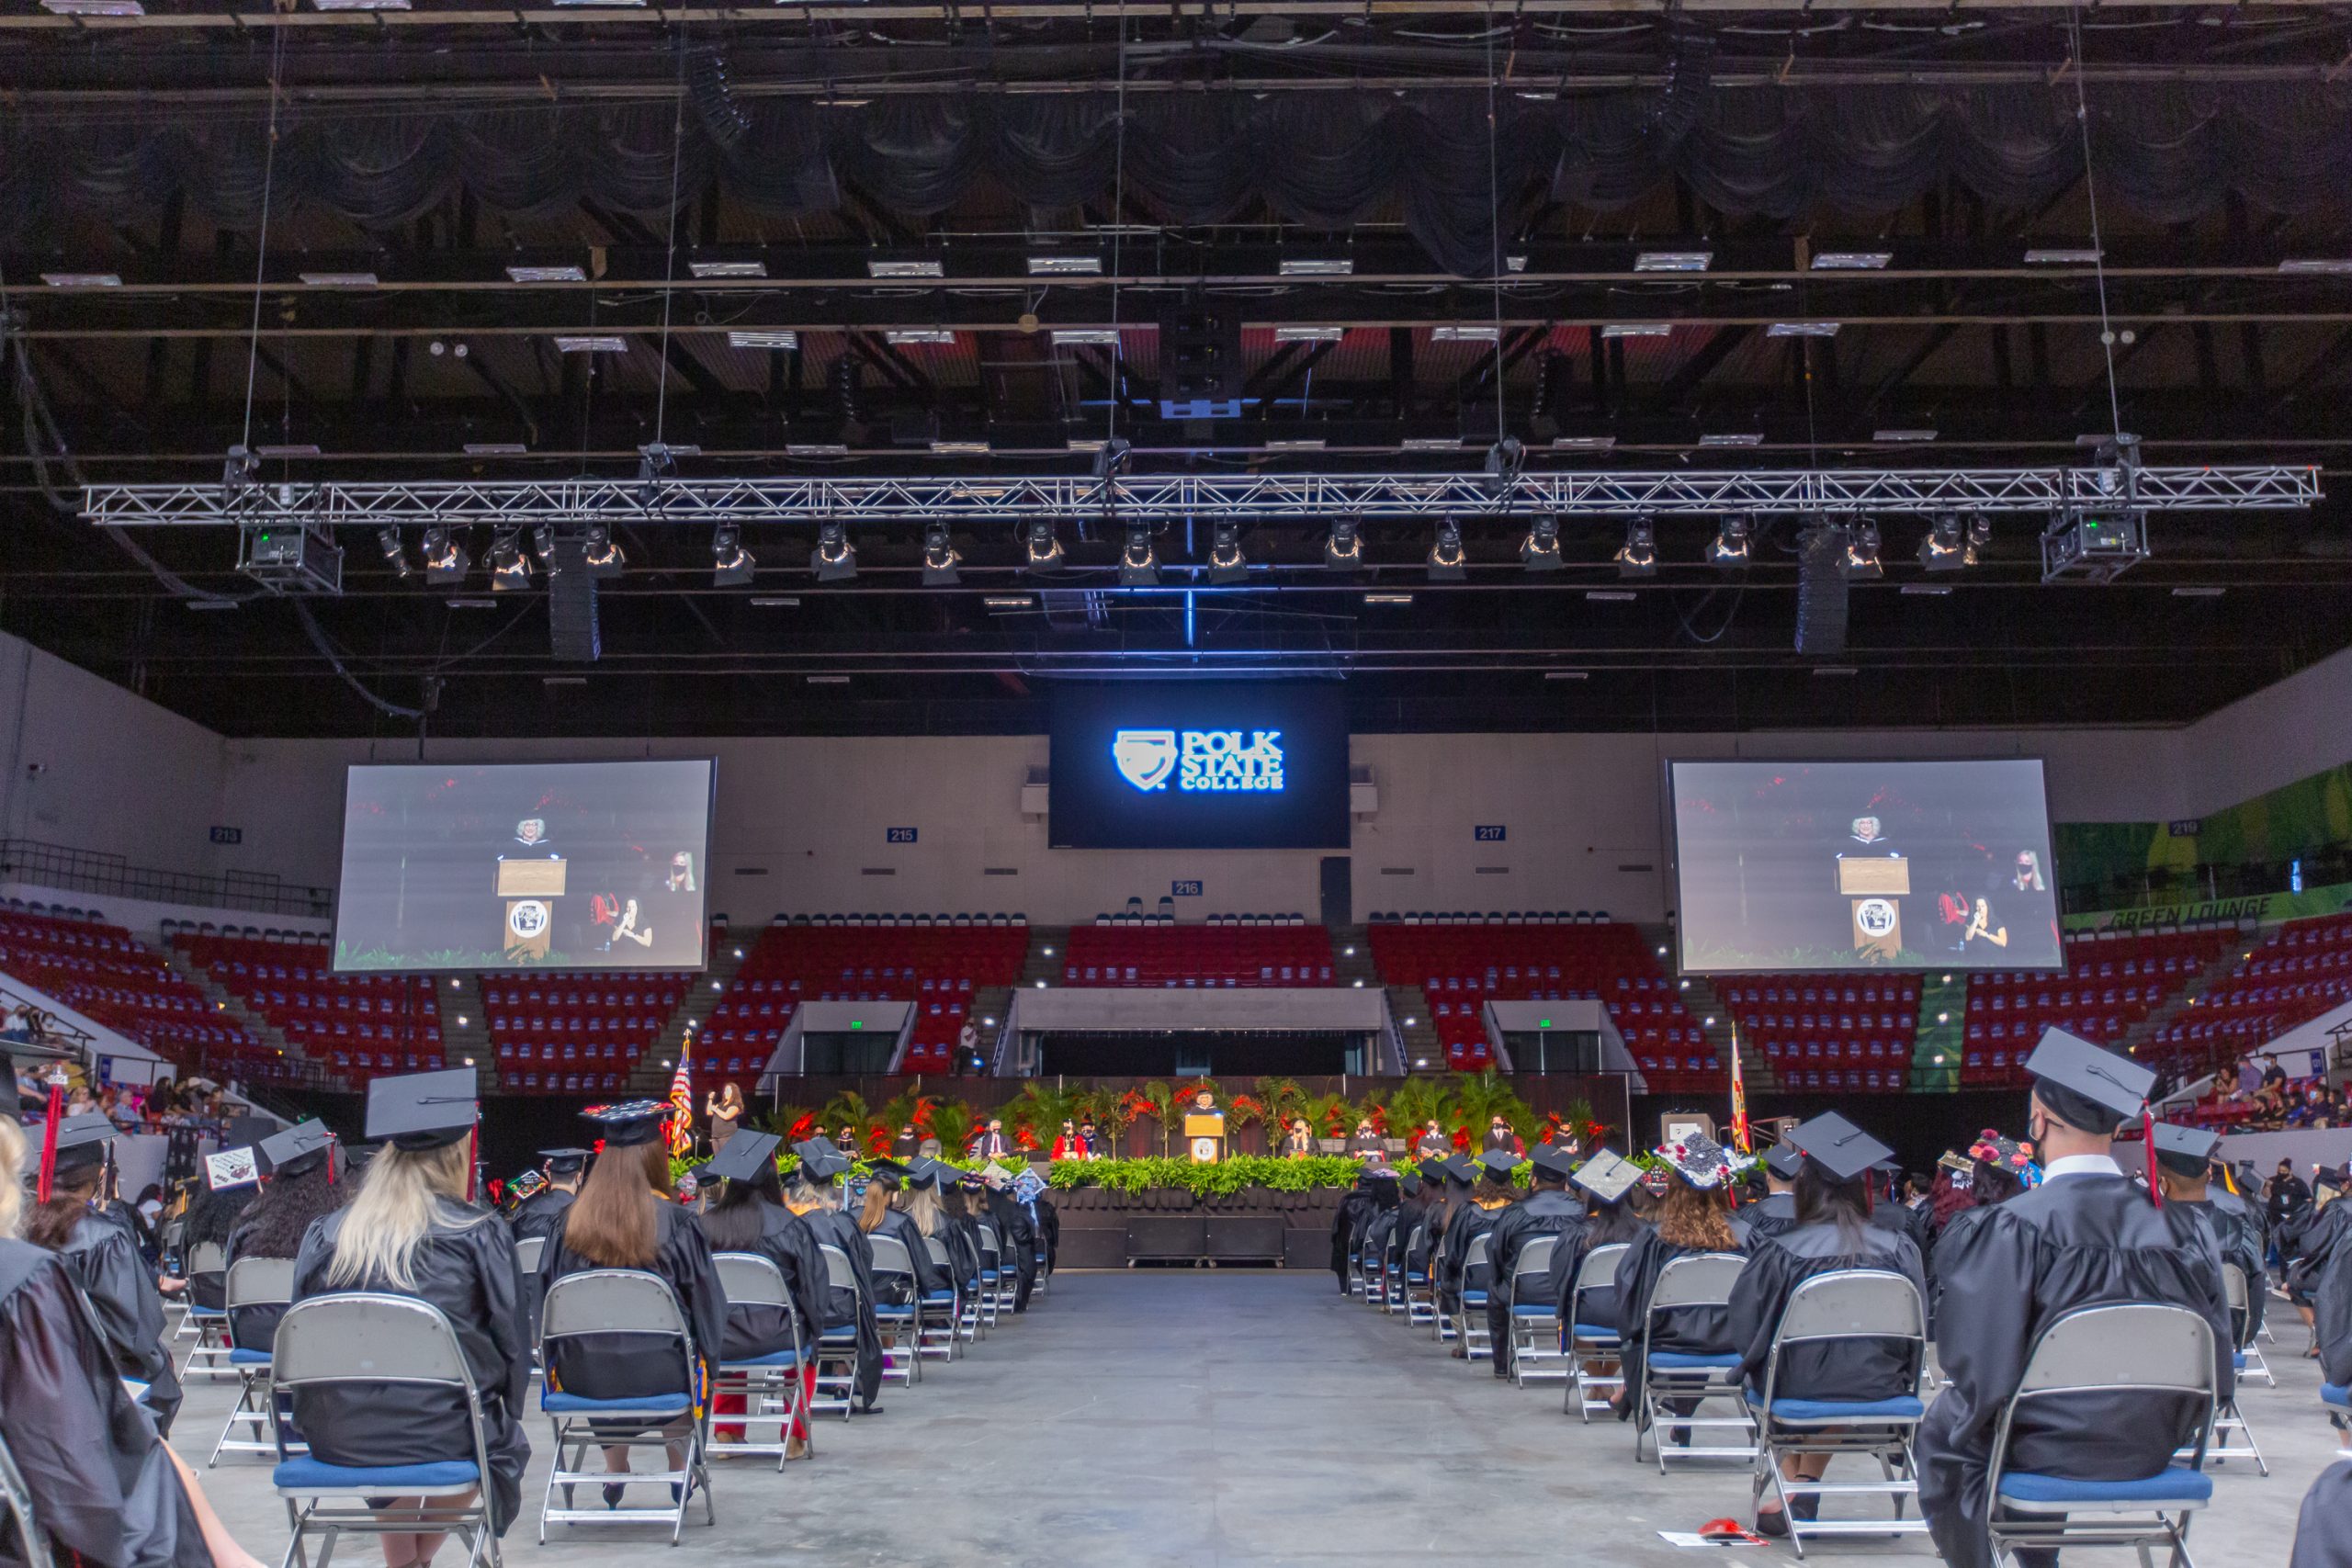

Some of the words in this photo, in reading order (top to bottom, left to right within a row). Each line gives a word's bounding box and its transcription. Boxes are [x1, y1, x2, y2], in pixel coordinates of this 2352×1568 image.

[1182, 731, 1283, 754] POLK
[1181, 754, 1283, 777] STATE
[1181, 776, 1283, 789] COLLEGE
[891, 829, 912, 841] 215
[1479, 828, 1501, 839] 217
[1176, 882, 1199, 895] 216
[2110, 905, 2182, 928] GREEN
[2187, 897, 2272, 921] LOUNGE
